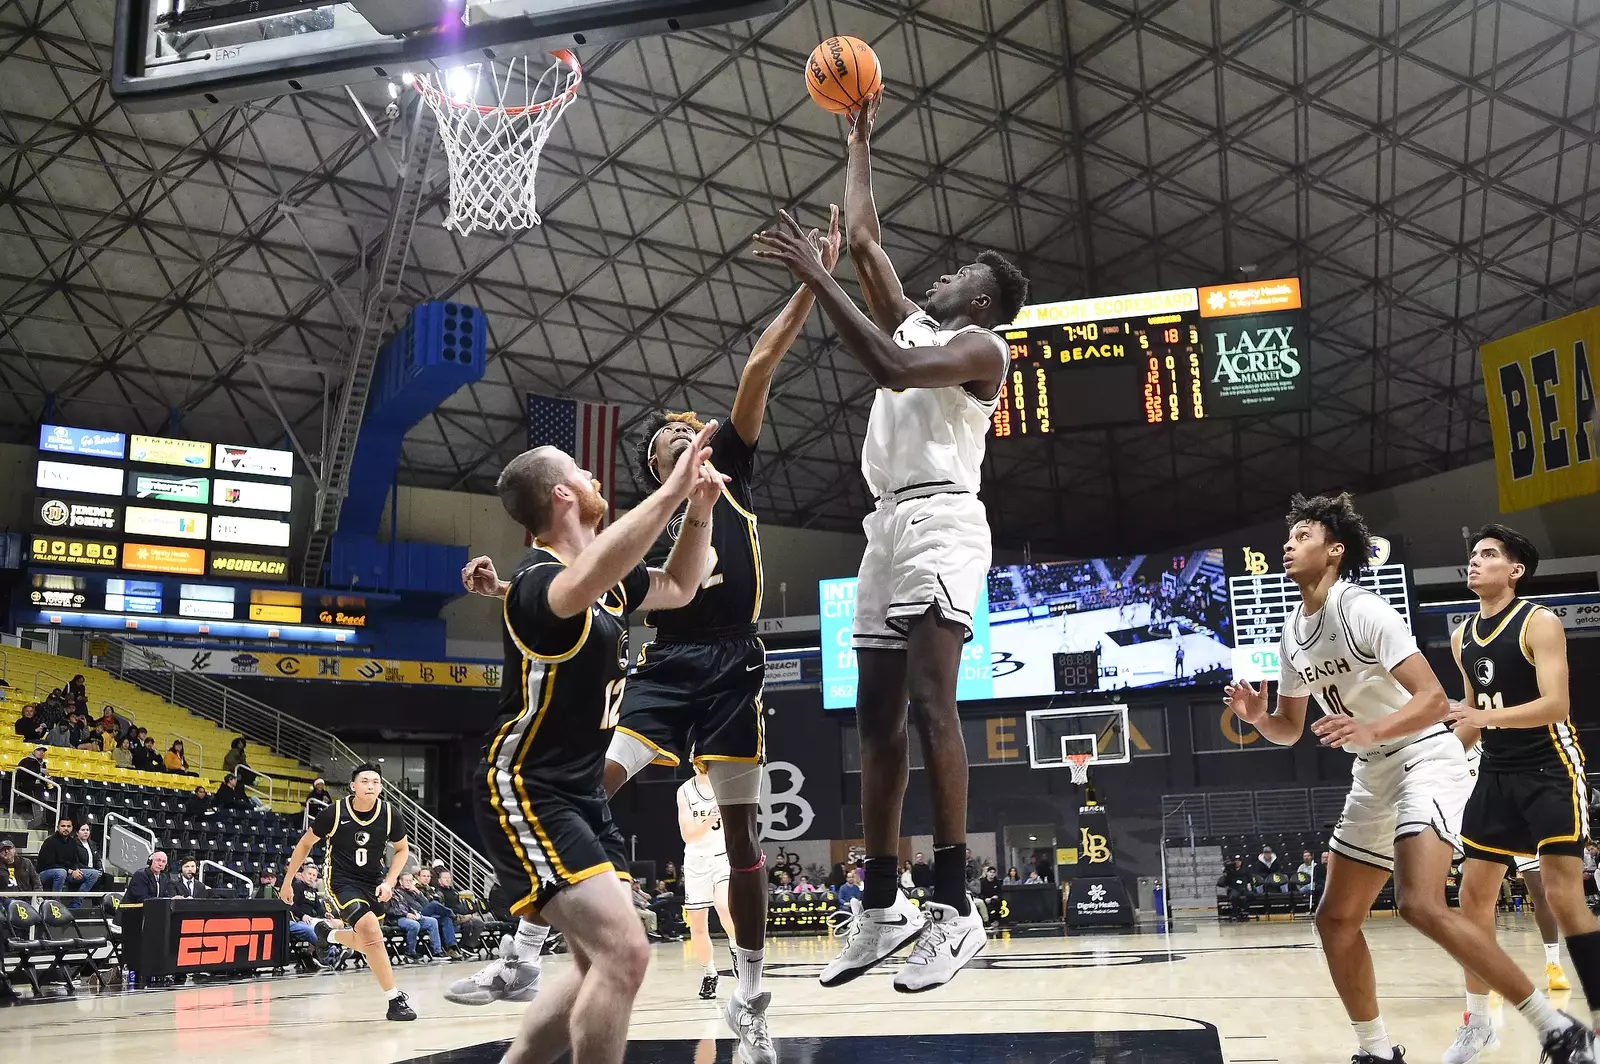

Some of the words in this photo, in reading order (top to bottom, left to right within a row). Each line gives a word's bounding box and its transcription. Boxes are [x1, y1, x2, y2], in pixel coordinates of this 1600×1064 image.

[215, 45, 245, 61] EAST
[826, 37, 848, 78] Wilson
[1093, 292, 1193, 315] SCOREBOARD
[1063, 323, 1098, 341] 7:40
[1164, 328, 1179, 344] 18
[1214, 326, 1294, 356] LAZY
[1009, 344, 1028, 360] 34
[1060, 344, 1124, 363] BEACH
[1211, 347, 1301, 383] ACRES
[70, 505, 114, 517] JIMMY
[70, 515, 115, 529] JOHN'S
[34, 553, 58, 561] FOLLOW
[97, 558, 115, 566] MEDIA
[213, 558, 285, 574] #GOBEACH
[320, 611, 332, 623] Go
[600, 677, 626, 730] 12
[1079, 805, 1105, 813] BEACH
[1080, 827, 1111, 864] LB
[355, 848, 368, 867] 0
[1077, 902, 1099, 910] Dignity
[177, 917, 274, 967] ESPN
